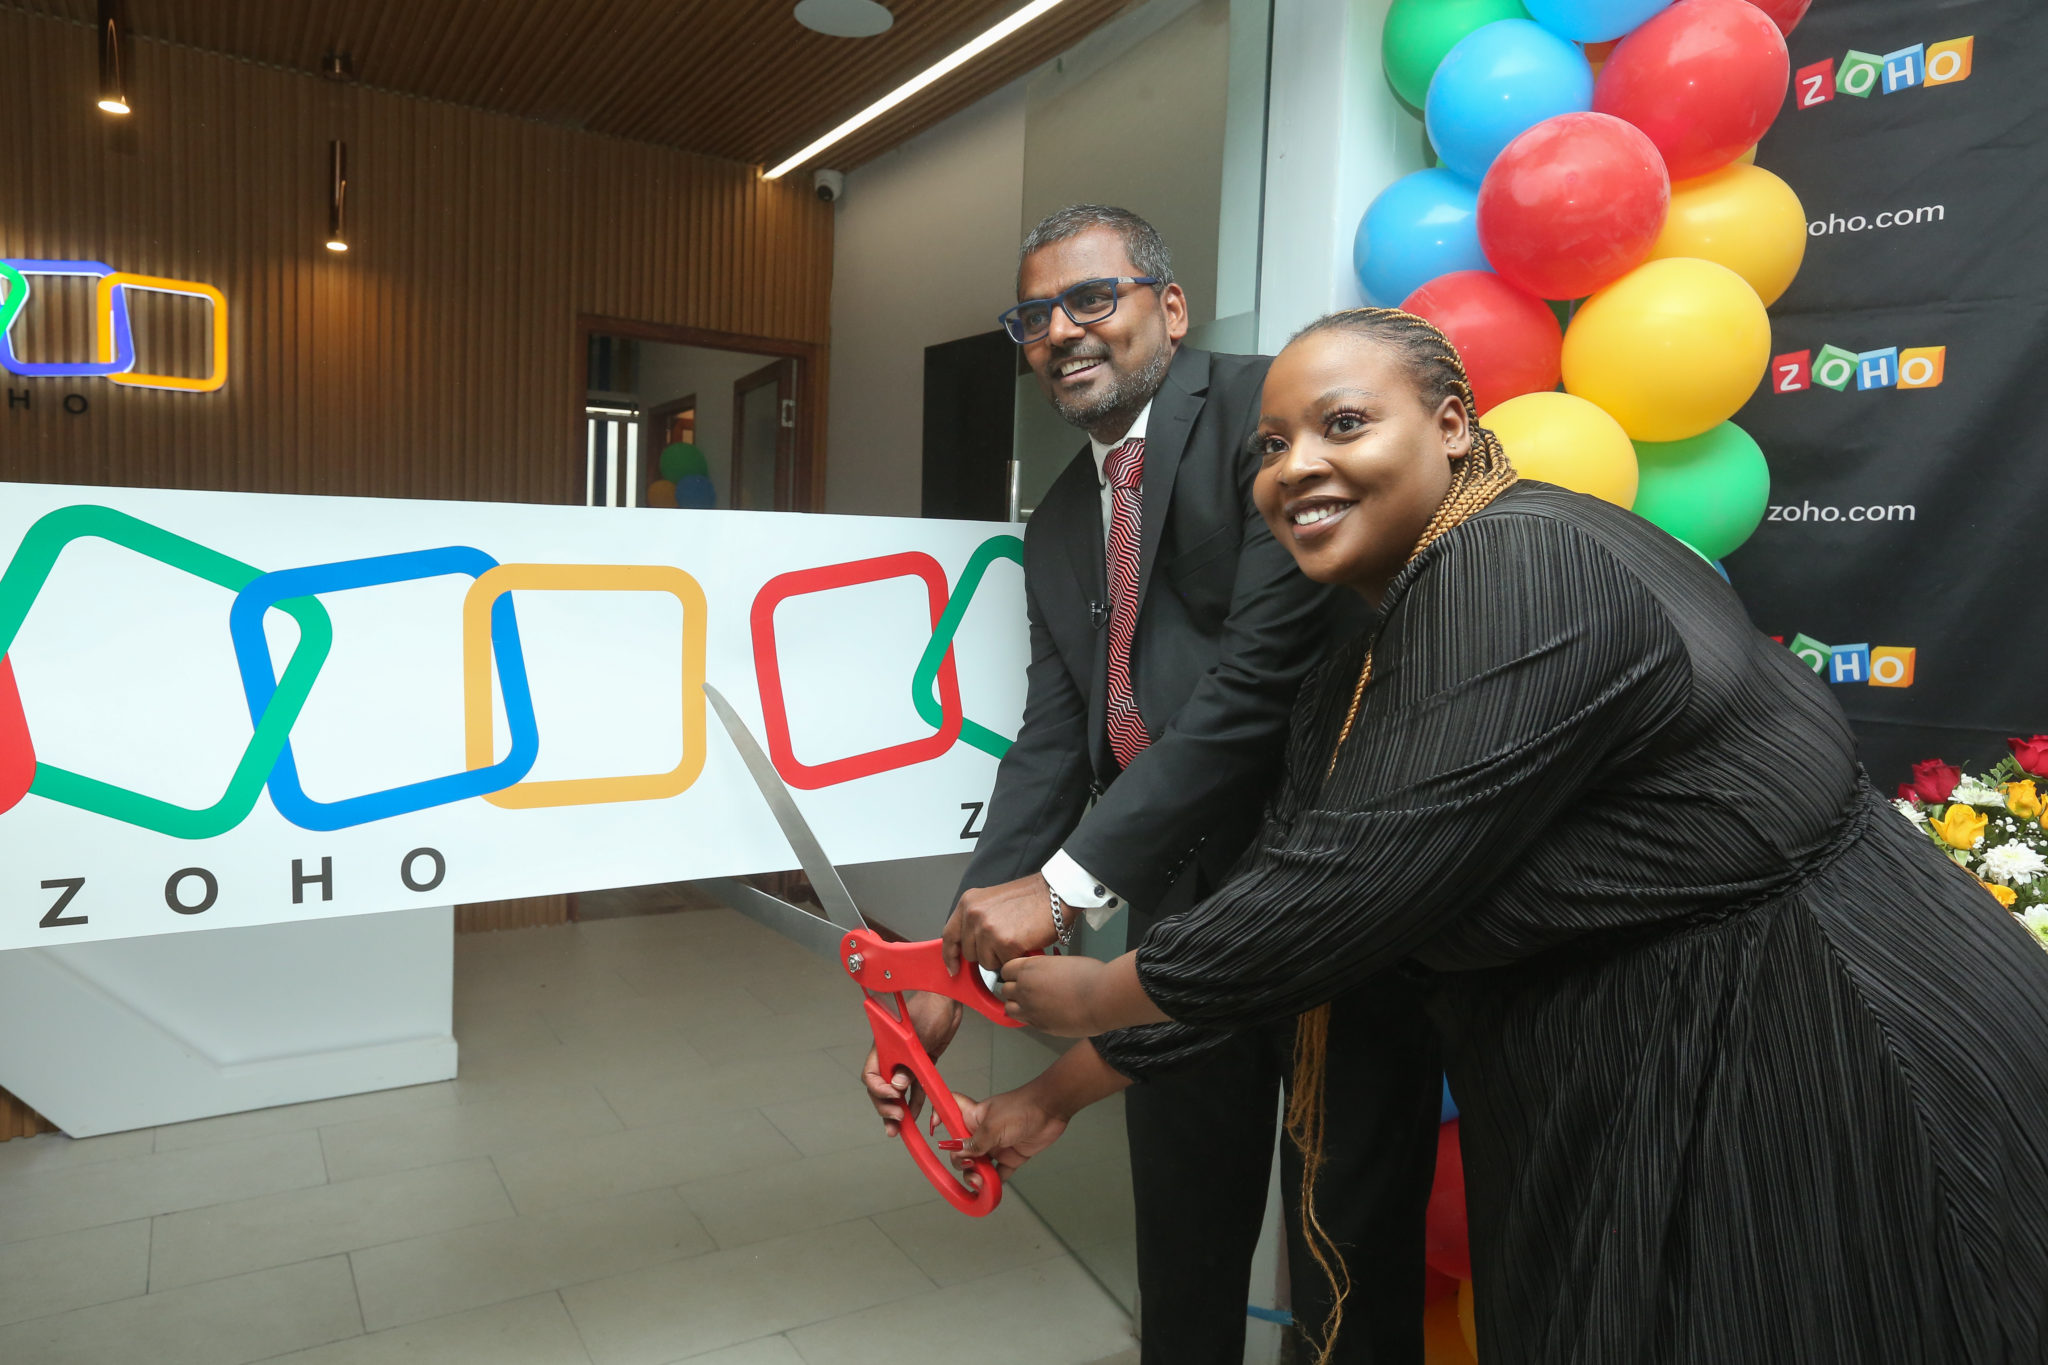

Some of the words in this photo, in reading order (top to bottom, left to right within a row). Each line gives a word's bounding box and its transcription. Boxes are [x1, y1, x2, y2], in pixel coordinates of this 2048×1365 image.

[1802, 50, 1961, 106] ZOHO
[1805, 204, 1945, 237] oho.com
[1779, 357, 1934, 392] ZOHO
[1767, 500, 1917, 522] zoho.com
[1796, 649, 1905, 684] OHO
[39, 847, 447, 929] ZOHO
